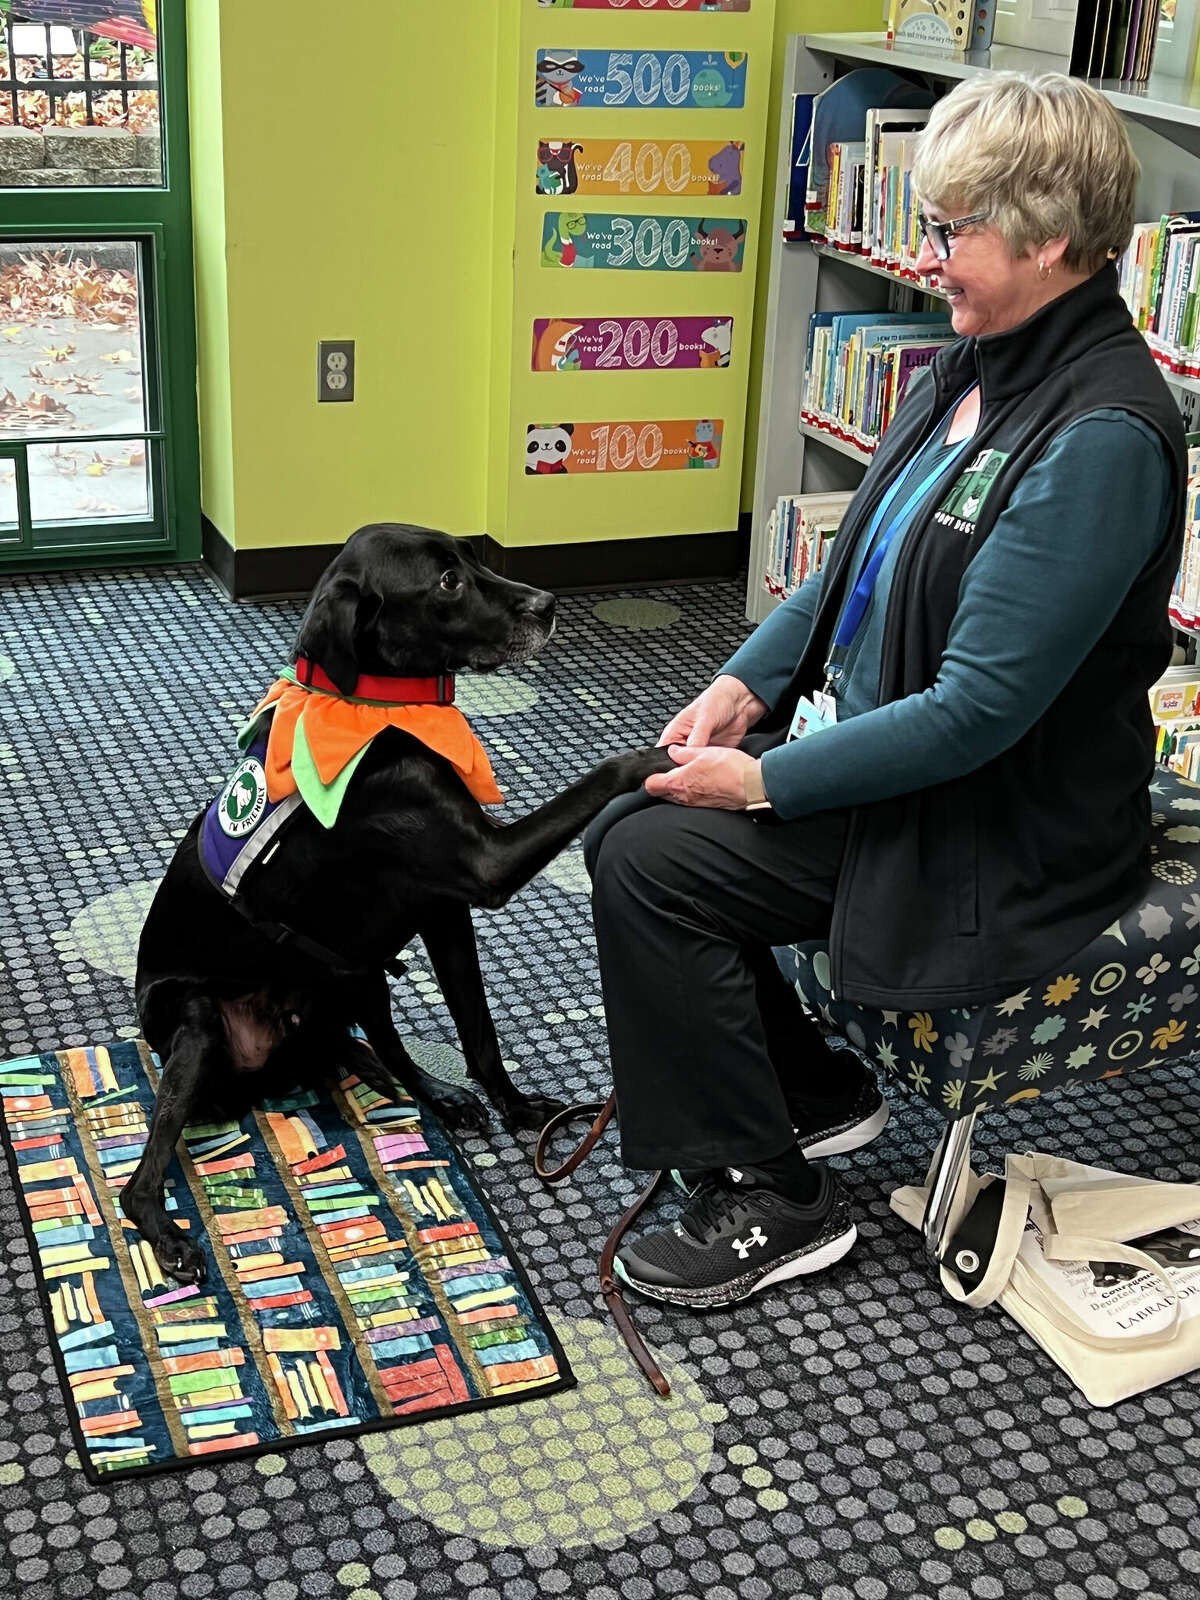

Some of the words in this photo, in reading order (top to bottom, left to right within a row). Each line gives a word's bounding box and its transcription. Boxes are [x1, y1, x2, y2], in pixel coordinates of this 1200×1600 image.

[579, 74, 606, 83] We've
[584, 84, 605, 93] read
[603, 52, 691, 105] 500
[693, 83, 721, 92] books!
[577, 163, 603, 171] We've
[582, 172, 602, 181] read
[602, 142, 691, 192] 400
[691, 174, 720, 182] books!
[586, 231, 612, 240] We've
[591, 241, 611, 250] read
[607, 217, 691, 267] 300
[691, 238, 718, 246] books!
[578, 335, 604, 344] We've
[583, 344, 603, 352] read
[595, 319, 679, 368] 200
[679, 342, 706, 351] books!
[571, 448, 596, 457] We've
[576, 456, 596, 465] read
[590, 423, 663, 471] 100
[663, 447, 690, 456] books!
[241, 787, 265, 830] FRIENDLY
